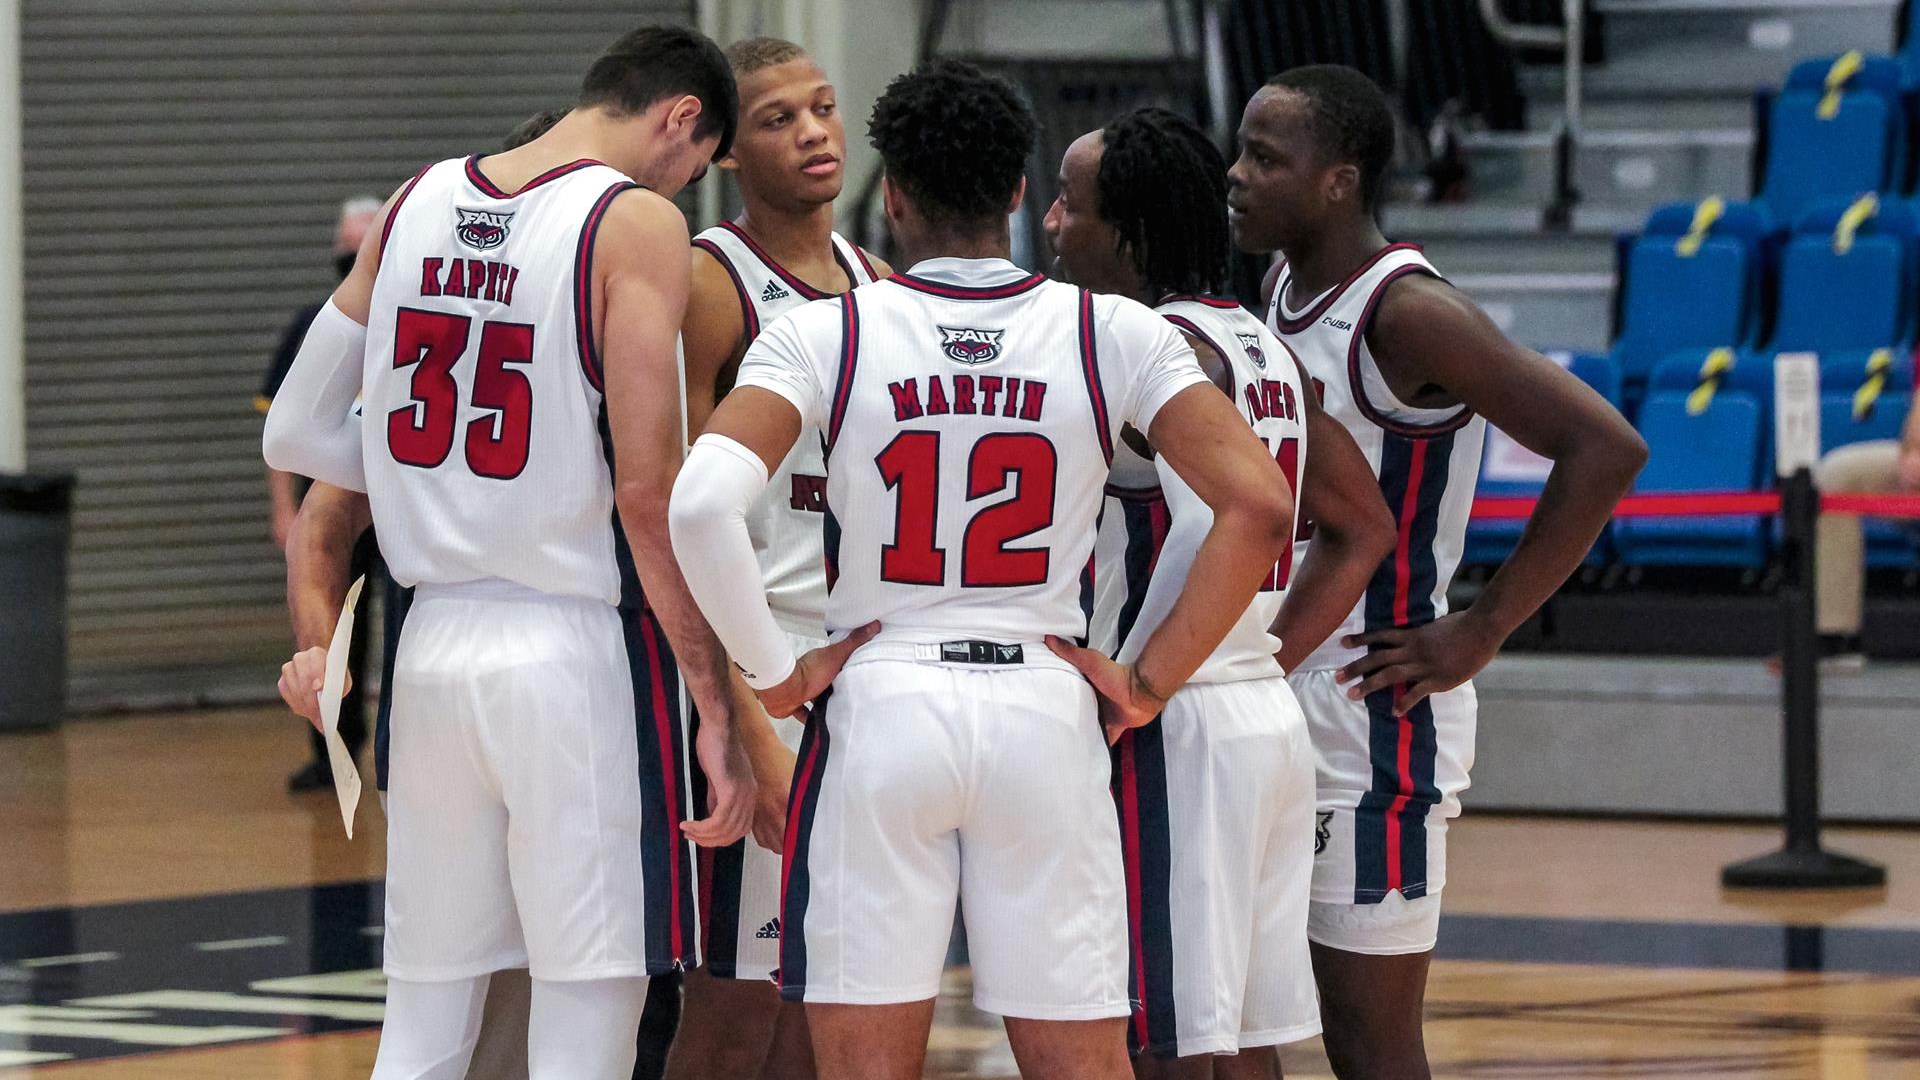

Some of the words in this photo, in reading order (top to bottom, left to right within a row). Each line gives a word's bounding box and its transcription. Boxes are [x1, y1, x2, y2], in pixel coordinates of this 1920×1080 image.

[460, 210, 512, 230] FAU
[761, 290, 790, 302] adidas
[942, 328, 1003, 346] FAU
[387, 306, 535, 480] 35
[888, 374, 1048, 422] MARTIN
[874, 429, 1058, 588] 12
